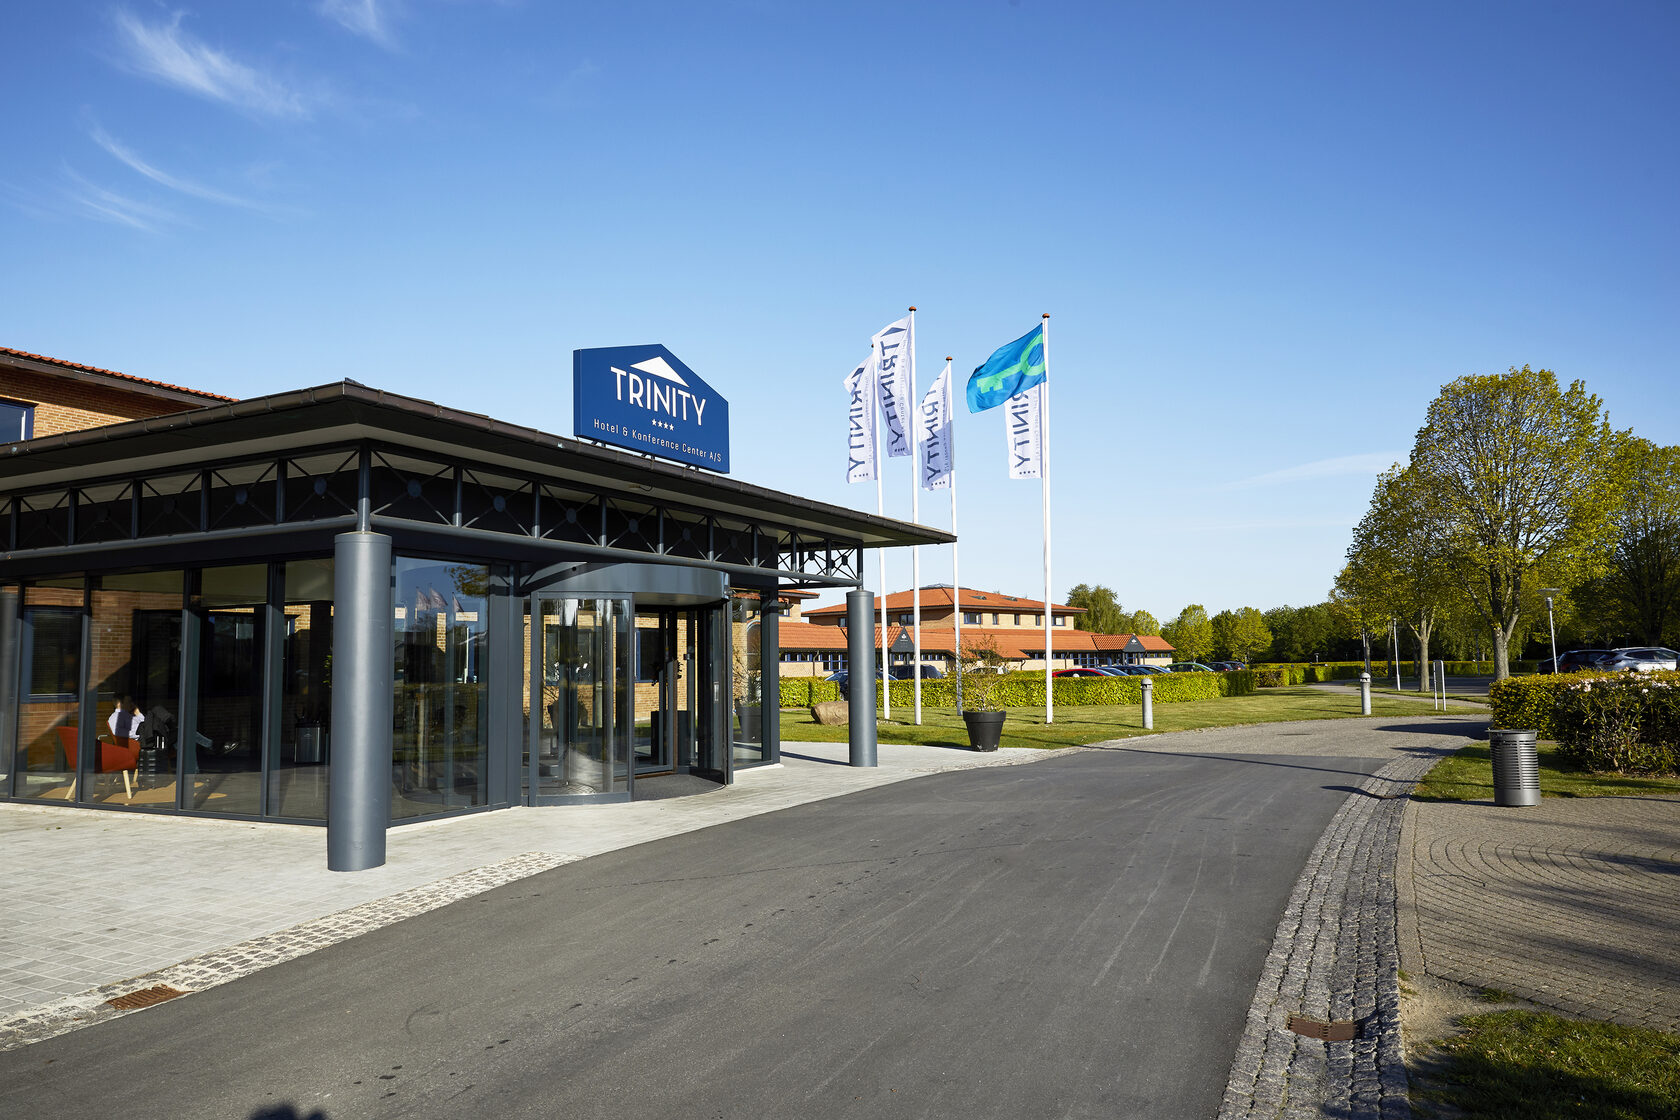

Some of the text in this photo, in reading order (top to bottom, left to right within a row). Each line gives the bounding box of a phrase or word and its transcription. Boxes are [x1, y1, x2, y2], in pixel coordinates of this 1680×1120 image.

[610, 366, 706, 426] TRINITY
[594, 418, 722, 463] Hotel & Konference Center A/S
